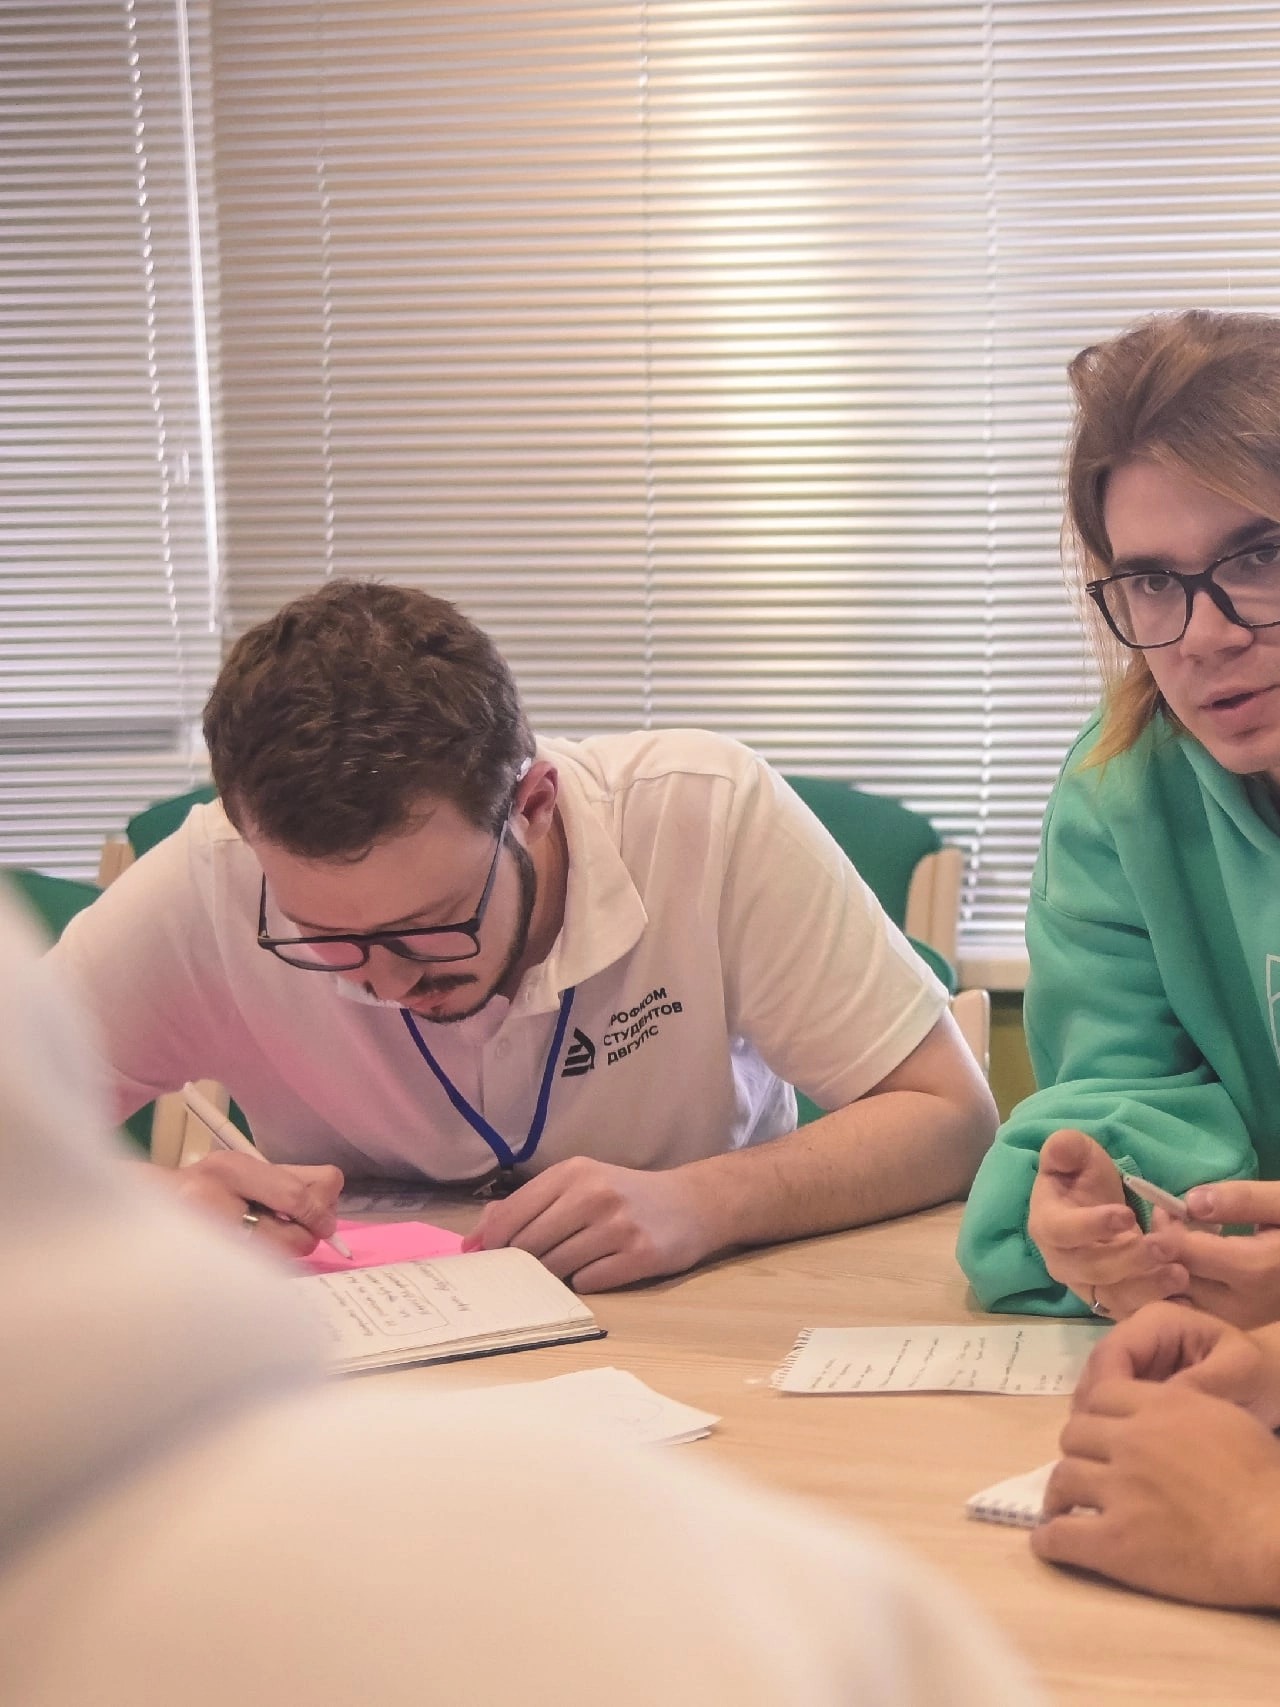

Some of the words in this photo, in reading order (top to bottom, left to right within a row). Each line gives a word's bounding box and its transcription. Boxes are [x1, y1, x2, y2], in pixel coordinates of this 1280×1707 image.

[603, 1001, 682, 1046] СТУДЕНТОВ
[609, 987, 667, 1027] РОФКОМ
[607, 1025, 659, 1066] ДВГУПС
